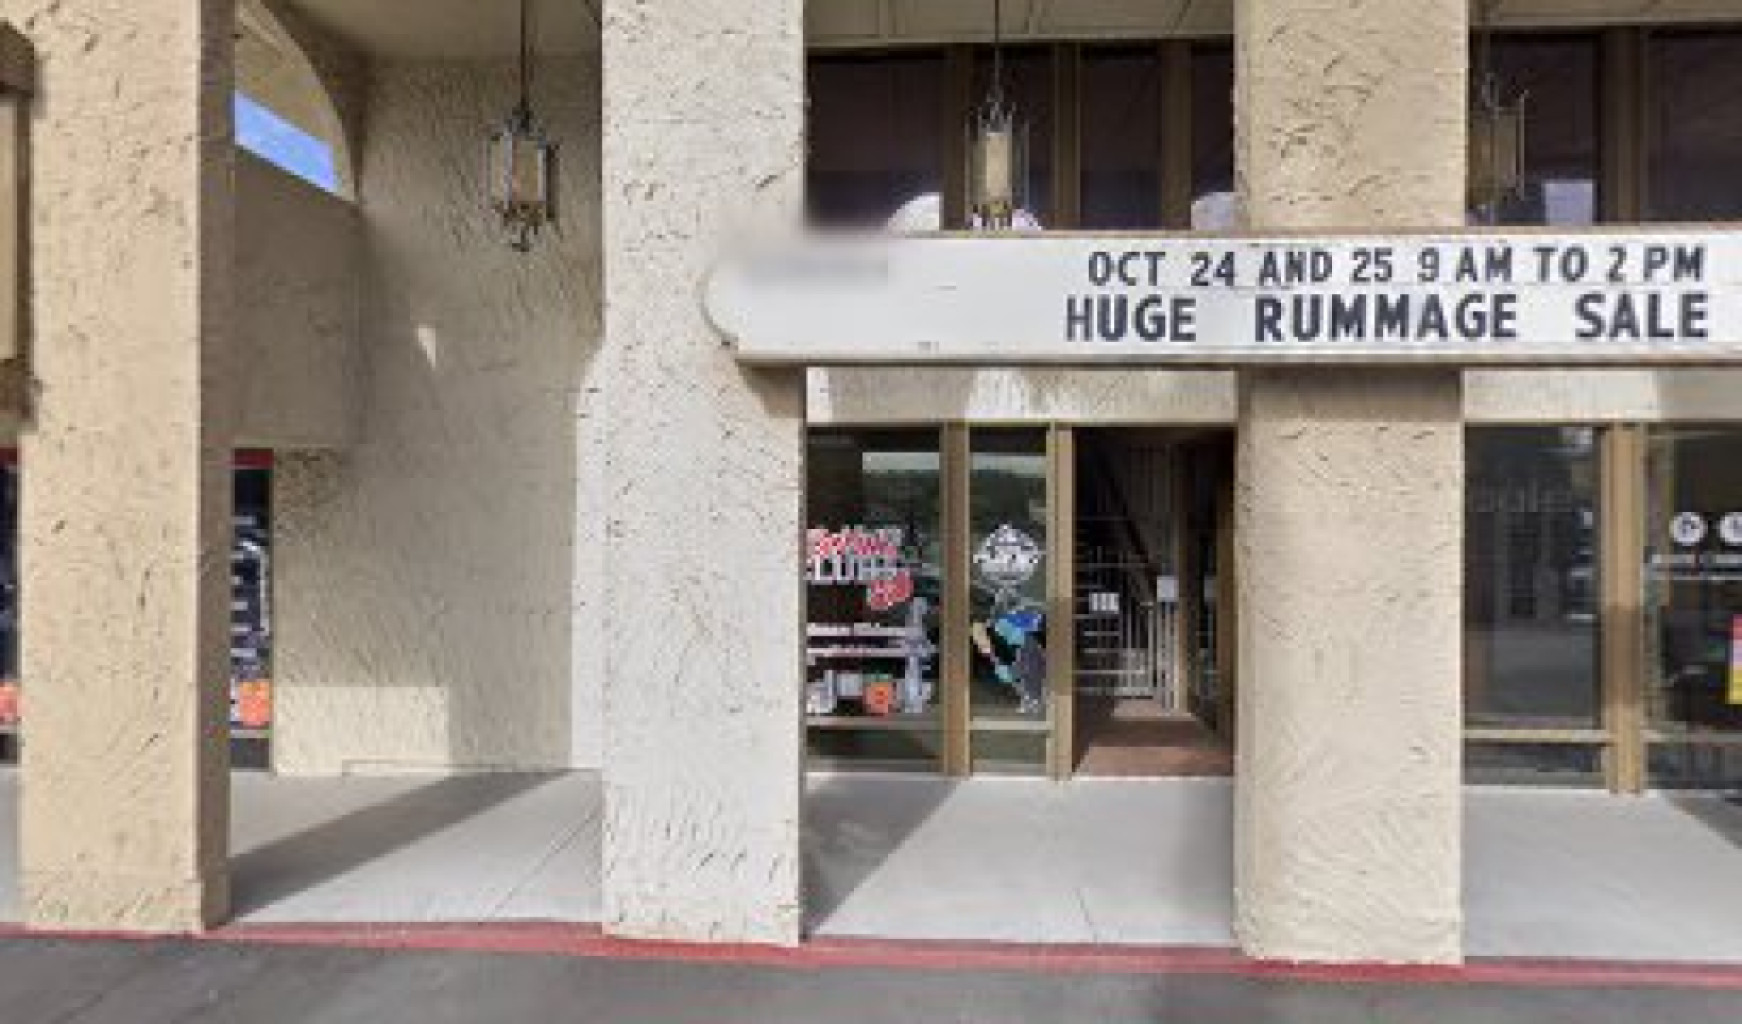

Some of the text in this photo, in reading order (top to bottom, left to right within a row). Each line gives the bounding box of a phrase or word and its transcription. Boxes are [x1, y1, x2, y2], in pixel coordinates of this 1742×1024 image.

[1088, 246, 1704, 286] OCT 24 AND 25 9 AM TO 2 PM
[1066, 292, 1709, 342] HUGE RUMMAGE SALE
